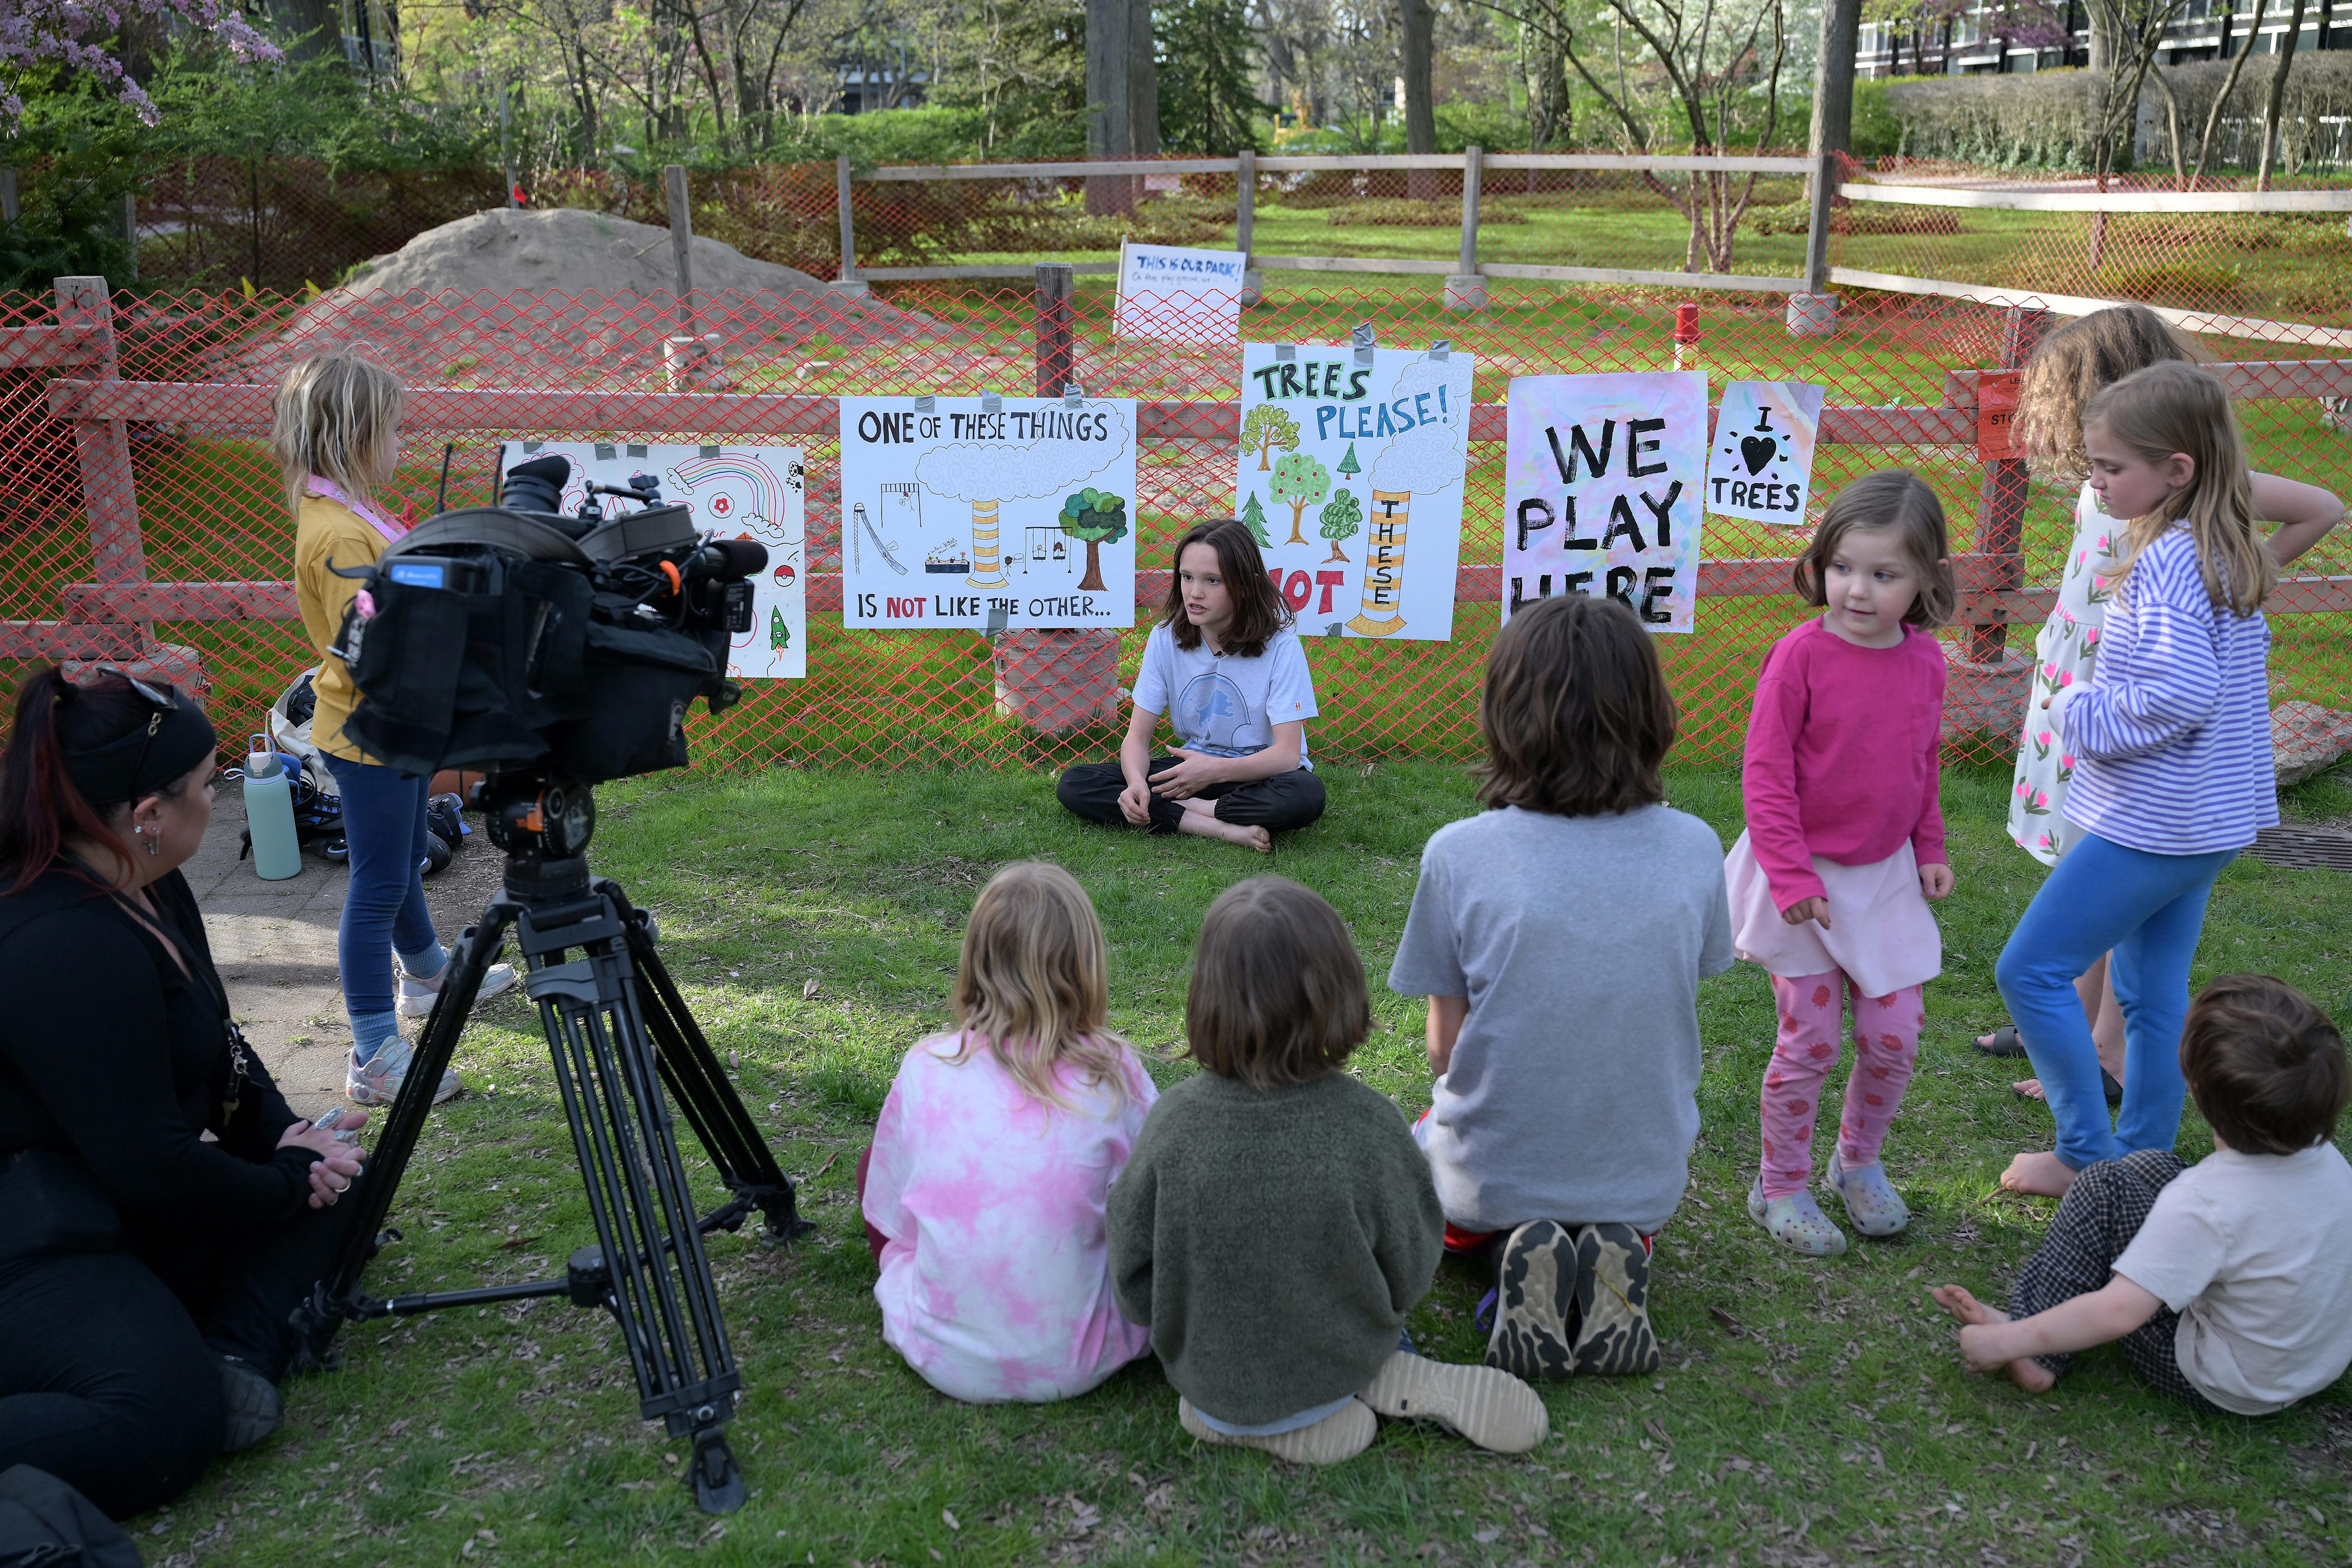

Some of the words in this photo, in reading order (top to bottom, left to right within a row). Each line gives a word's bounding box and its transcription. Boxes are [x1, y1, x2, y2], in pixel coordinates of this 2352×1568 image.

[1137, 256, 1167, 270] THIS
[1170, 258, 1179, 271] IS
[1181, 258, 1203, 273] OUR
[1206, 261, 1241, 282] PARK!
[1253, 361, 1373, 402] TREES
[858, 411, 914, 443] ONE
[919, 416, 941, 438] OF
[951, 412, 1005, 440] THESE
[1010, 411, 1108, 441] THINGS
[1316, 384, 1448, 441] PLEASE!
[1754, 407, 1773, 432] I
[1545, 418, 1668, 484] WE
[1711, 478, 1800, 512] TREES
[1516, 480, 1683, 552] PLAY
[1372, 499, 1399, 605] THESE
[858, 593, 877, 618] IS
[886, 597, 927, 618] NOT
[936, 595, 980, 617] LIKE
[987, 597, 1019, 616] THE
[1029, 596, 1111, 616] OTHER...
